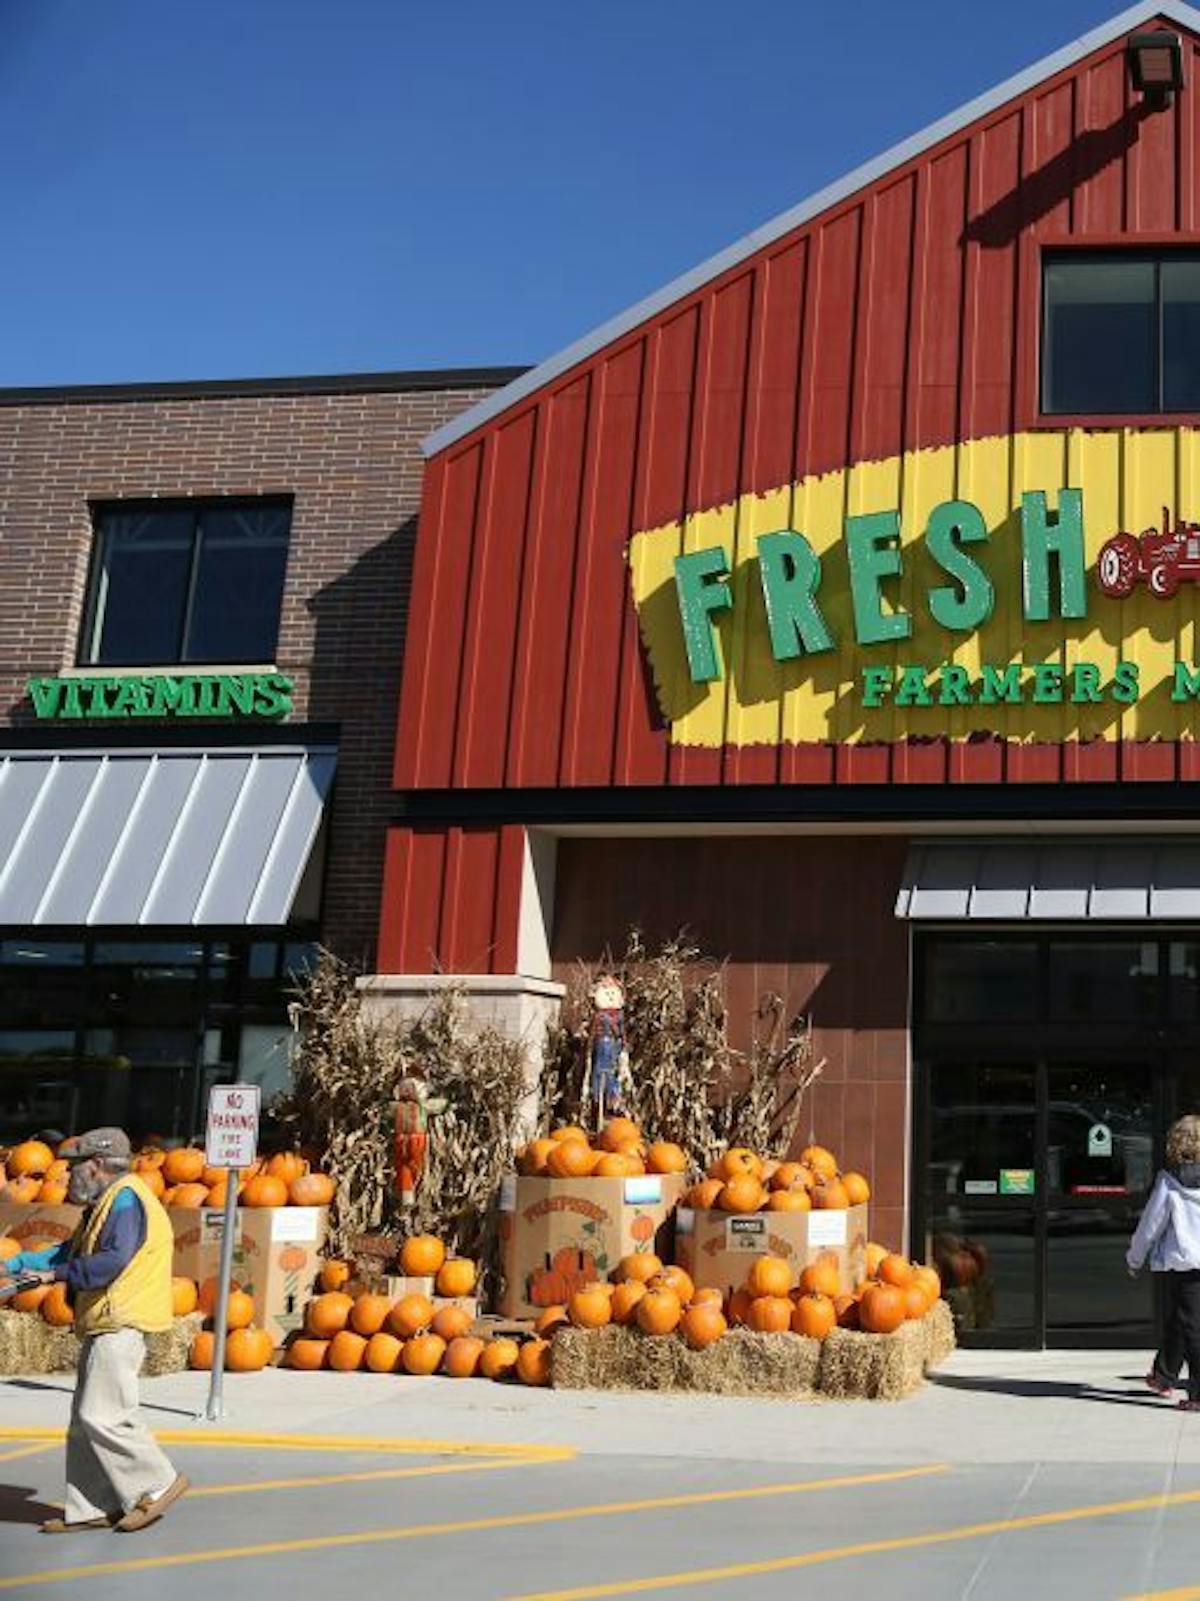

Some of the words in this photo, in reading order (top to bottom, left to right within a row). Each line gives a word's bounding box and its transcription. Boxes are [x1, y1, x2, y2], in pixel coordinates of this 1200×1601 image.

[675, 488, 1087, 684] FRESH
[26, 674, 294, 718] VITAMINS
[860, 662, 1141, 707] FARMERS
[212, 1113, 256, 1131] PARKING
[225, 1092, 244, 1110] NO
